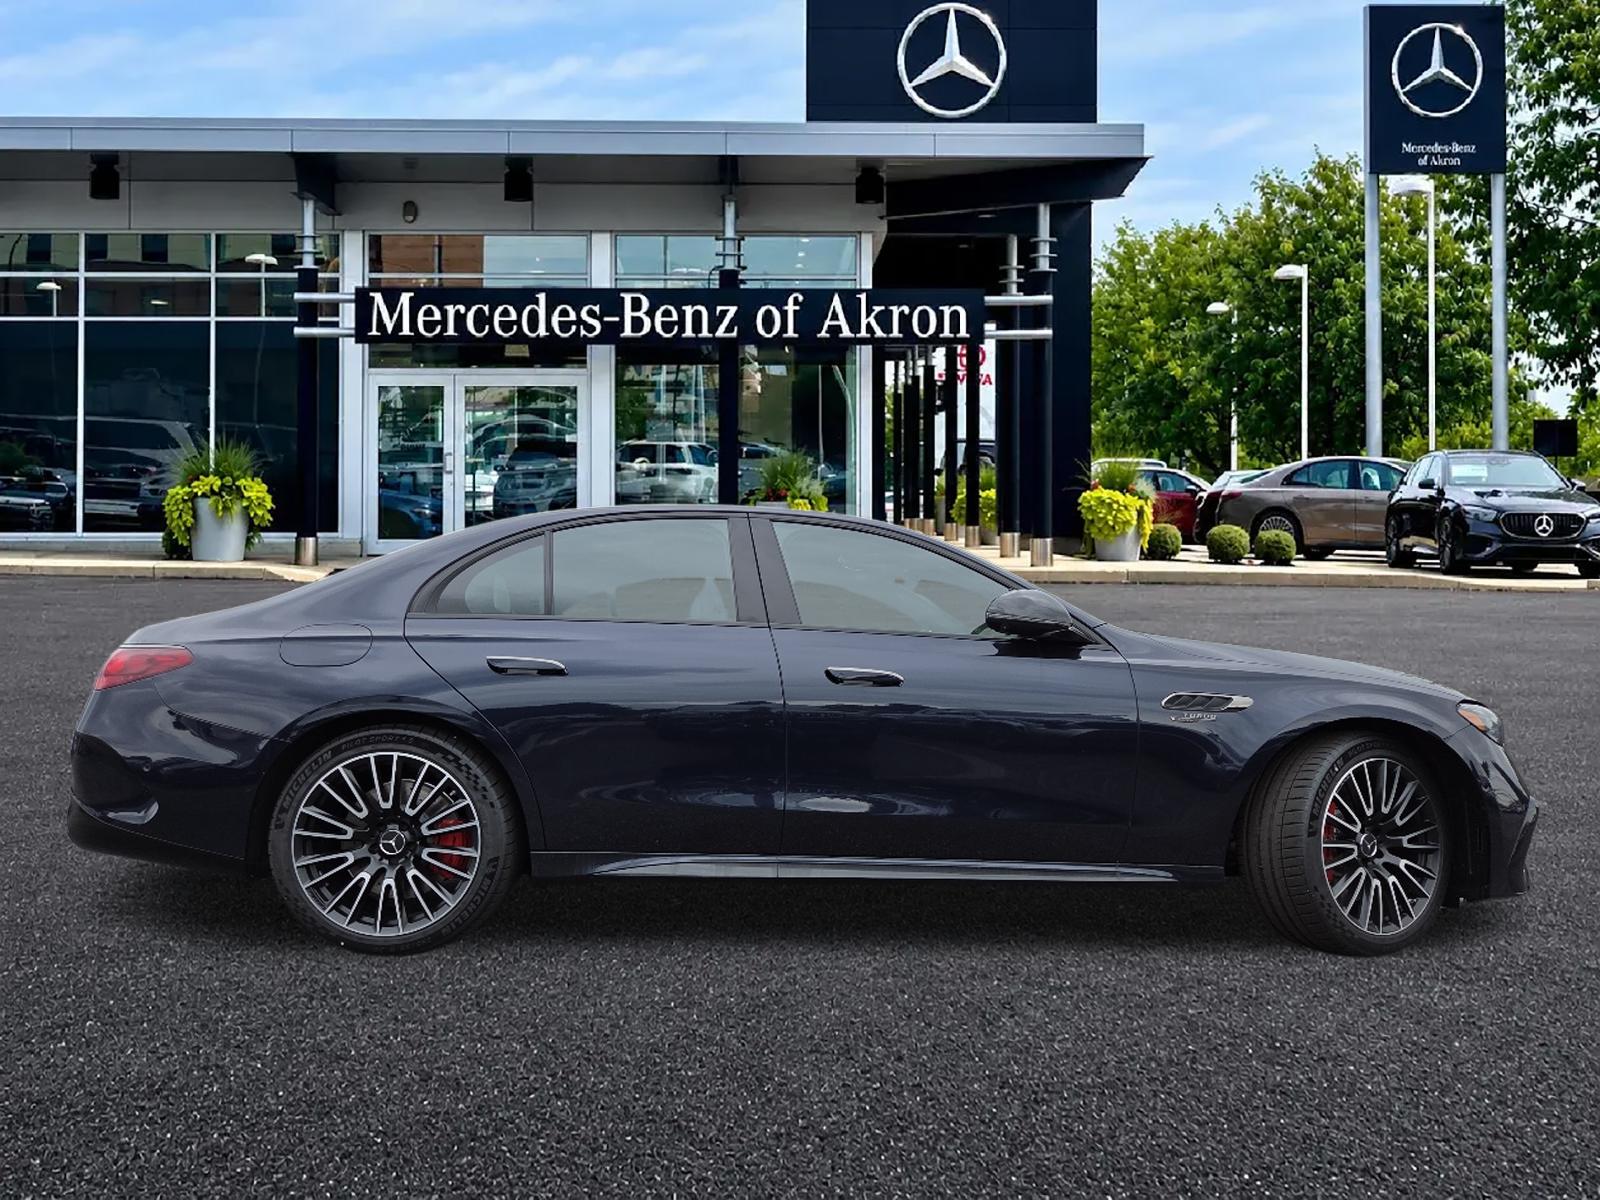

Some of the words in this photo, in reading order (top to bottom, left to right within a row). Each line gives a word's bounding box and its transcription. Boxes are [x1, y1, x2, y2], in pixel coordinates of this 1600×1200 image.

[1402, 142, 1476, 153] Mercedes-Benz
[1418, 155, 1428, 165] of
[1430, 155, 1460, 165] Akron
[368, 292, 737, 337] Mercedes-Benz
[756, 293, 803, 337] of
[817, 292, 970, 337] Akron
[282, 750, 332, 808] MICHELIN
[1312, 757, 1345, 817] MICHELIN
[441, 874, 493, 935] MICHELIN
